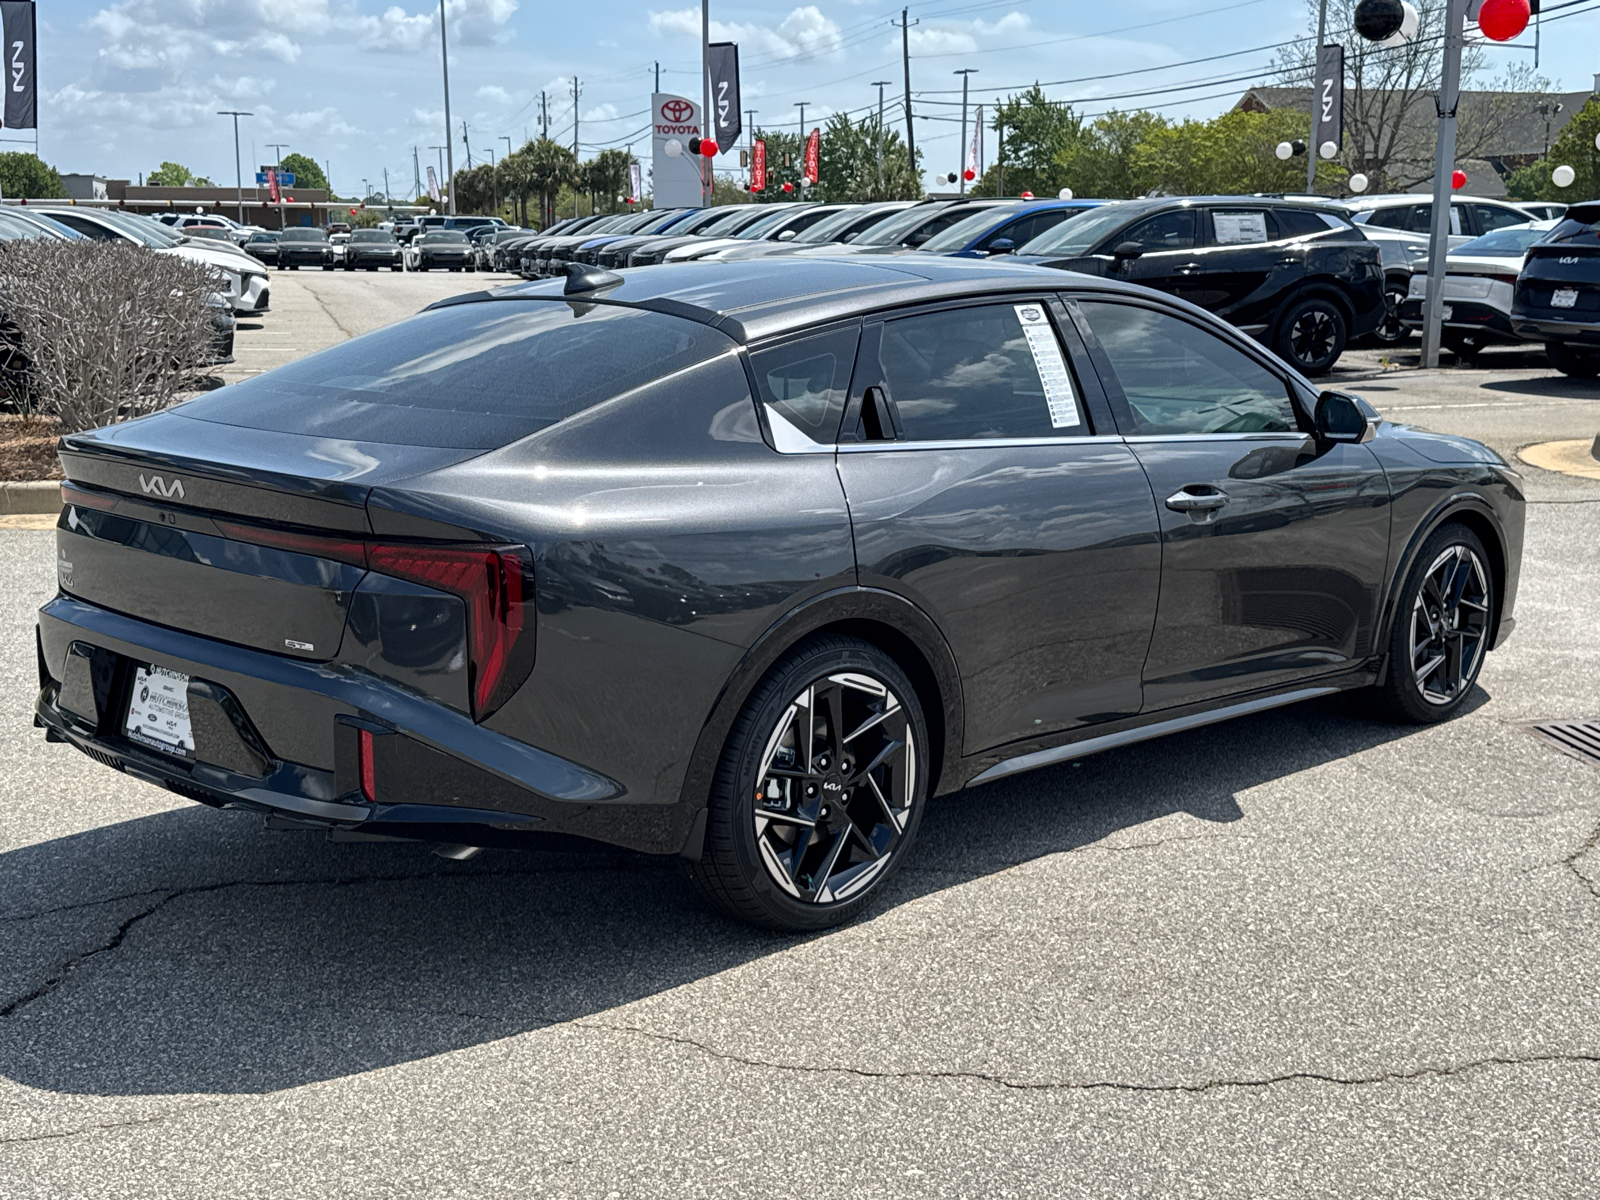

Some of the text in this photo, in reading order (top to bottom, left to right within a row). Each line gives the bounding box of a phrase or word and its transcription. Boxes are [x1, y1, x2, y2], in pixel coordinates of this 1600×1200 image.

[655, 125, 699, 135] TOYOTA
[139, 473, 186, 500] KIA
[149, 694, 190, 713] HUTCHINSO
[823, 782, 841, 791] KIA
